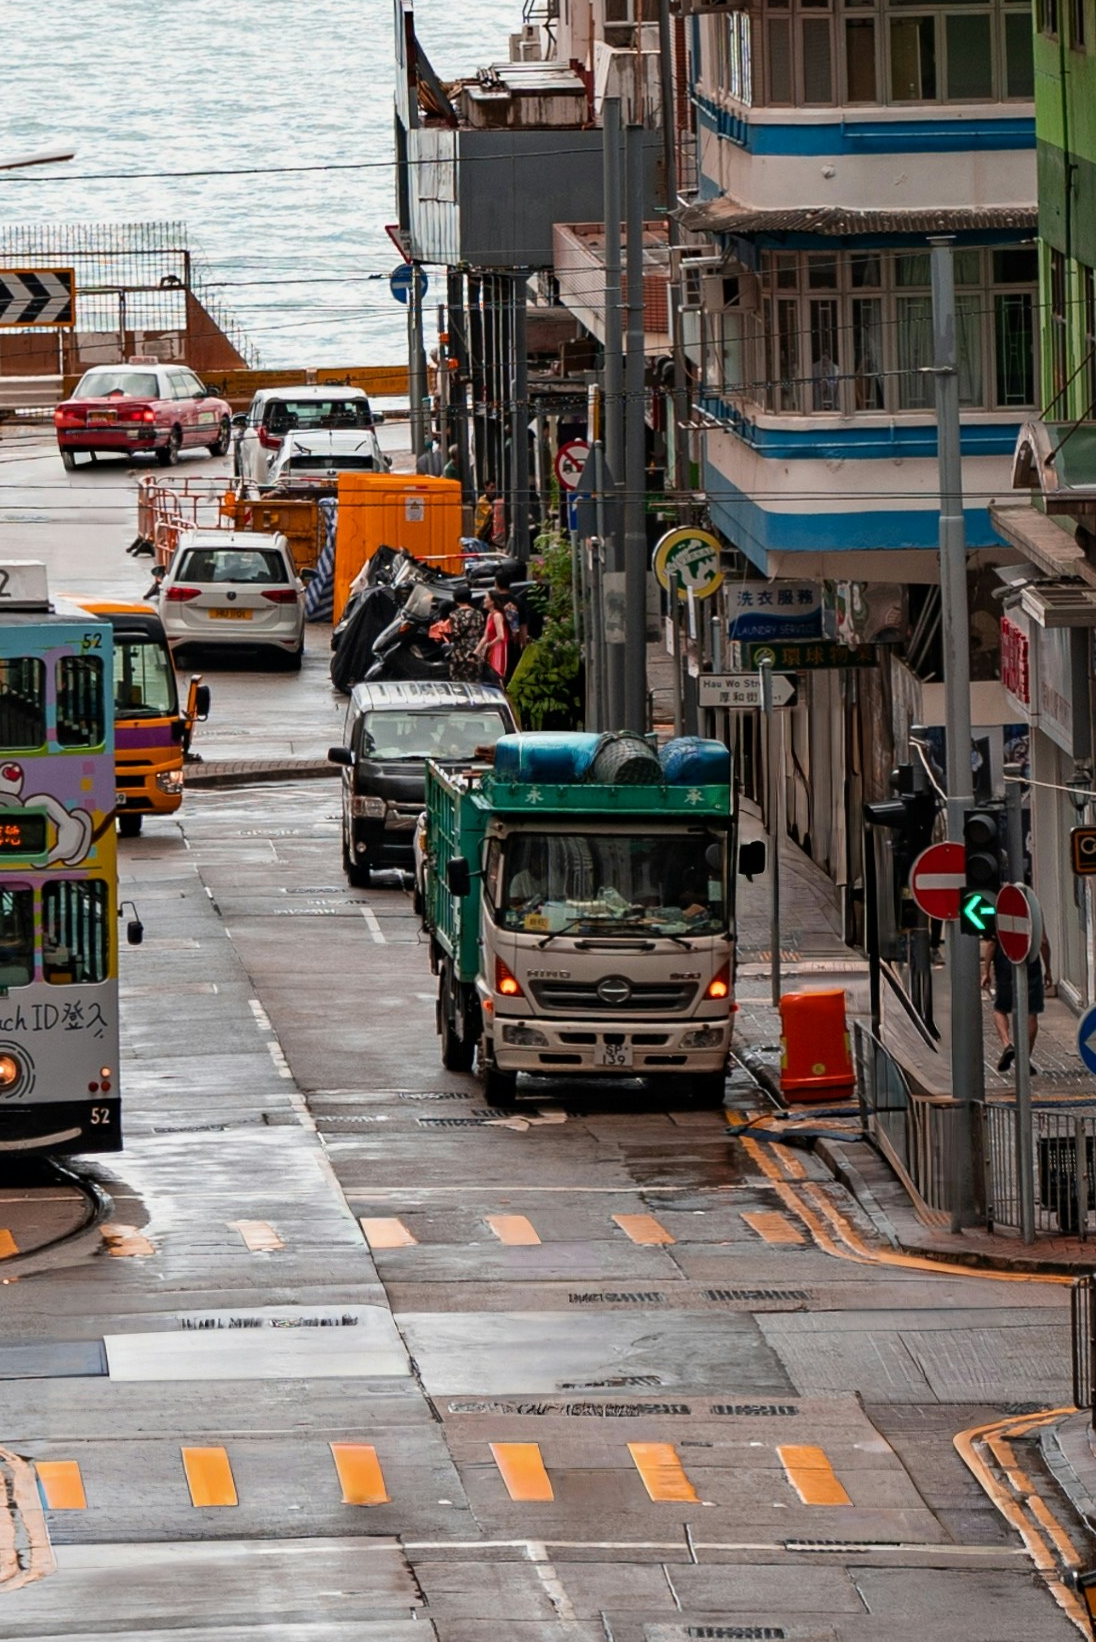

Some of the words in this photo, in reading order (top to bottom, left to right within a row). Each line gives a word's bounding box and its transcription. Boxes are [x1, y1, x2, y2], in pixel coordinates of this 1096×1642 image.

[737, 589, 813, 606] 洗衣服務
[737, 625, 776, 636] LAUNDRY
[82, 633, 102, 649] 52
[703, 680, 722, 688] Hau
[725, 680, 740, 688] Wo
[527, 969, 571, 979] HINO
[605, 1045, 623, 1056] SP
[603, 1055, 626, 1066] 139
[91, 1108, 110, 1124] 52
